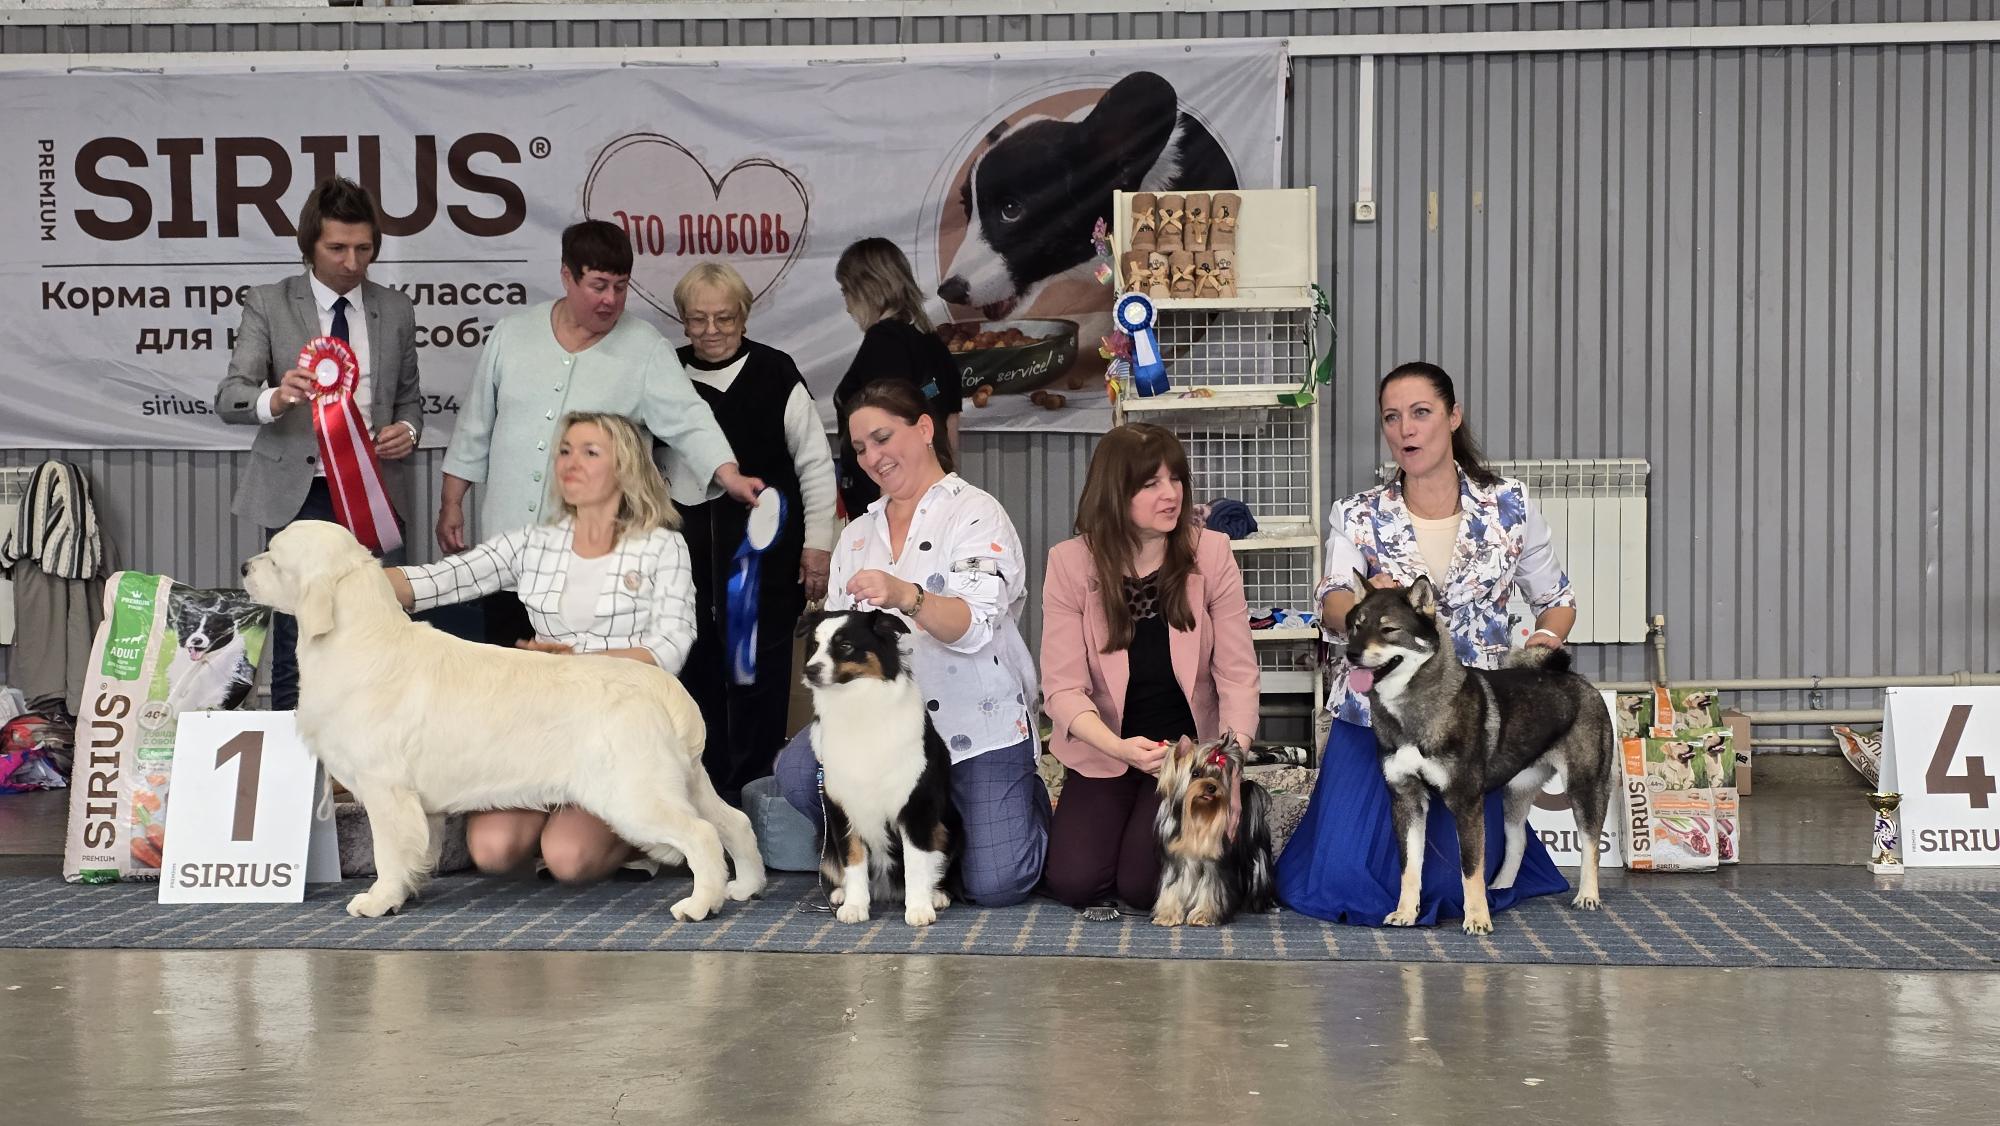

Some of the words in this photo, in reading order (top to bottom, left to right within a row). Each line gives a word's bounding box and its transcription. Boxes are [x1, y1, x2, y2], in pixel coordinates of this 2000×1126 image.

[38, 139, 56, 241] PREMIUM
[613, 210, 665, 257] ЭТО
[676, 212, 790, 257] ЛЮБОВЬ
[41, 281, 171, 316] Корма
[136, 328, 212, 355] для
[142, 394, 214, 416] sirius.
[419, 395, 460, 415] 234
[110, 646, 140, 660] ADULT
[1925, 704, 1997, 809] 4
[214, 730, 265, 842] 1
[1919, 828, 2000, 853] SIRIU
